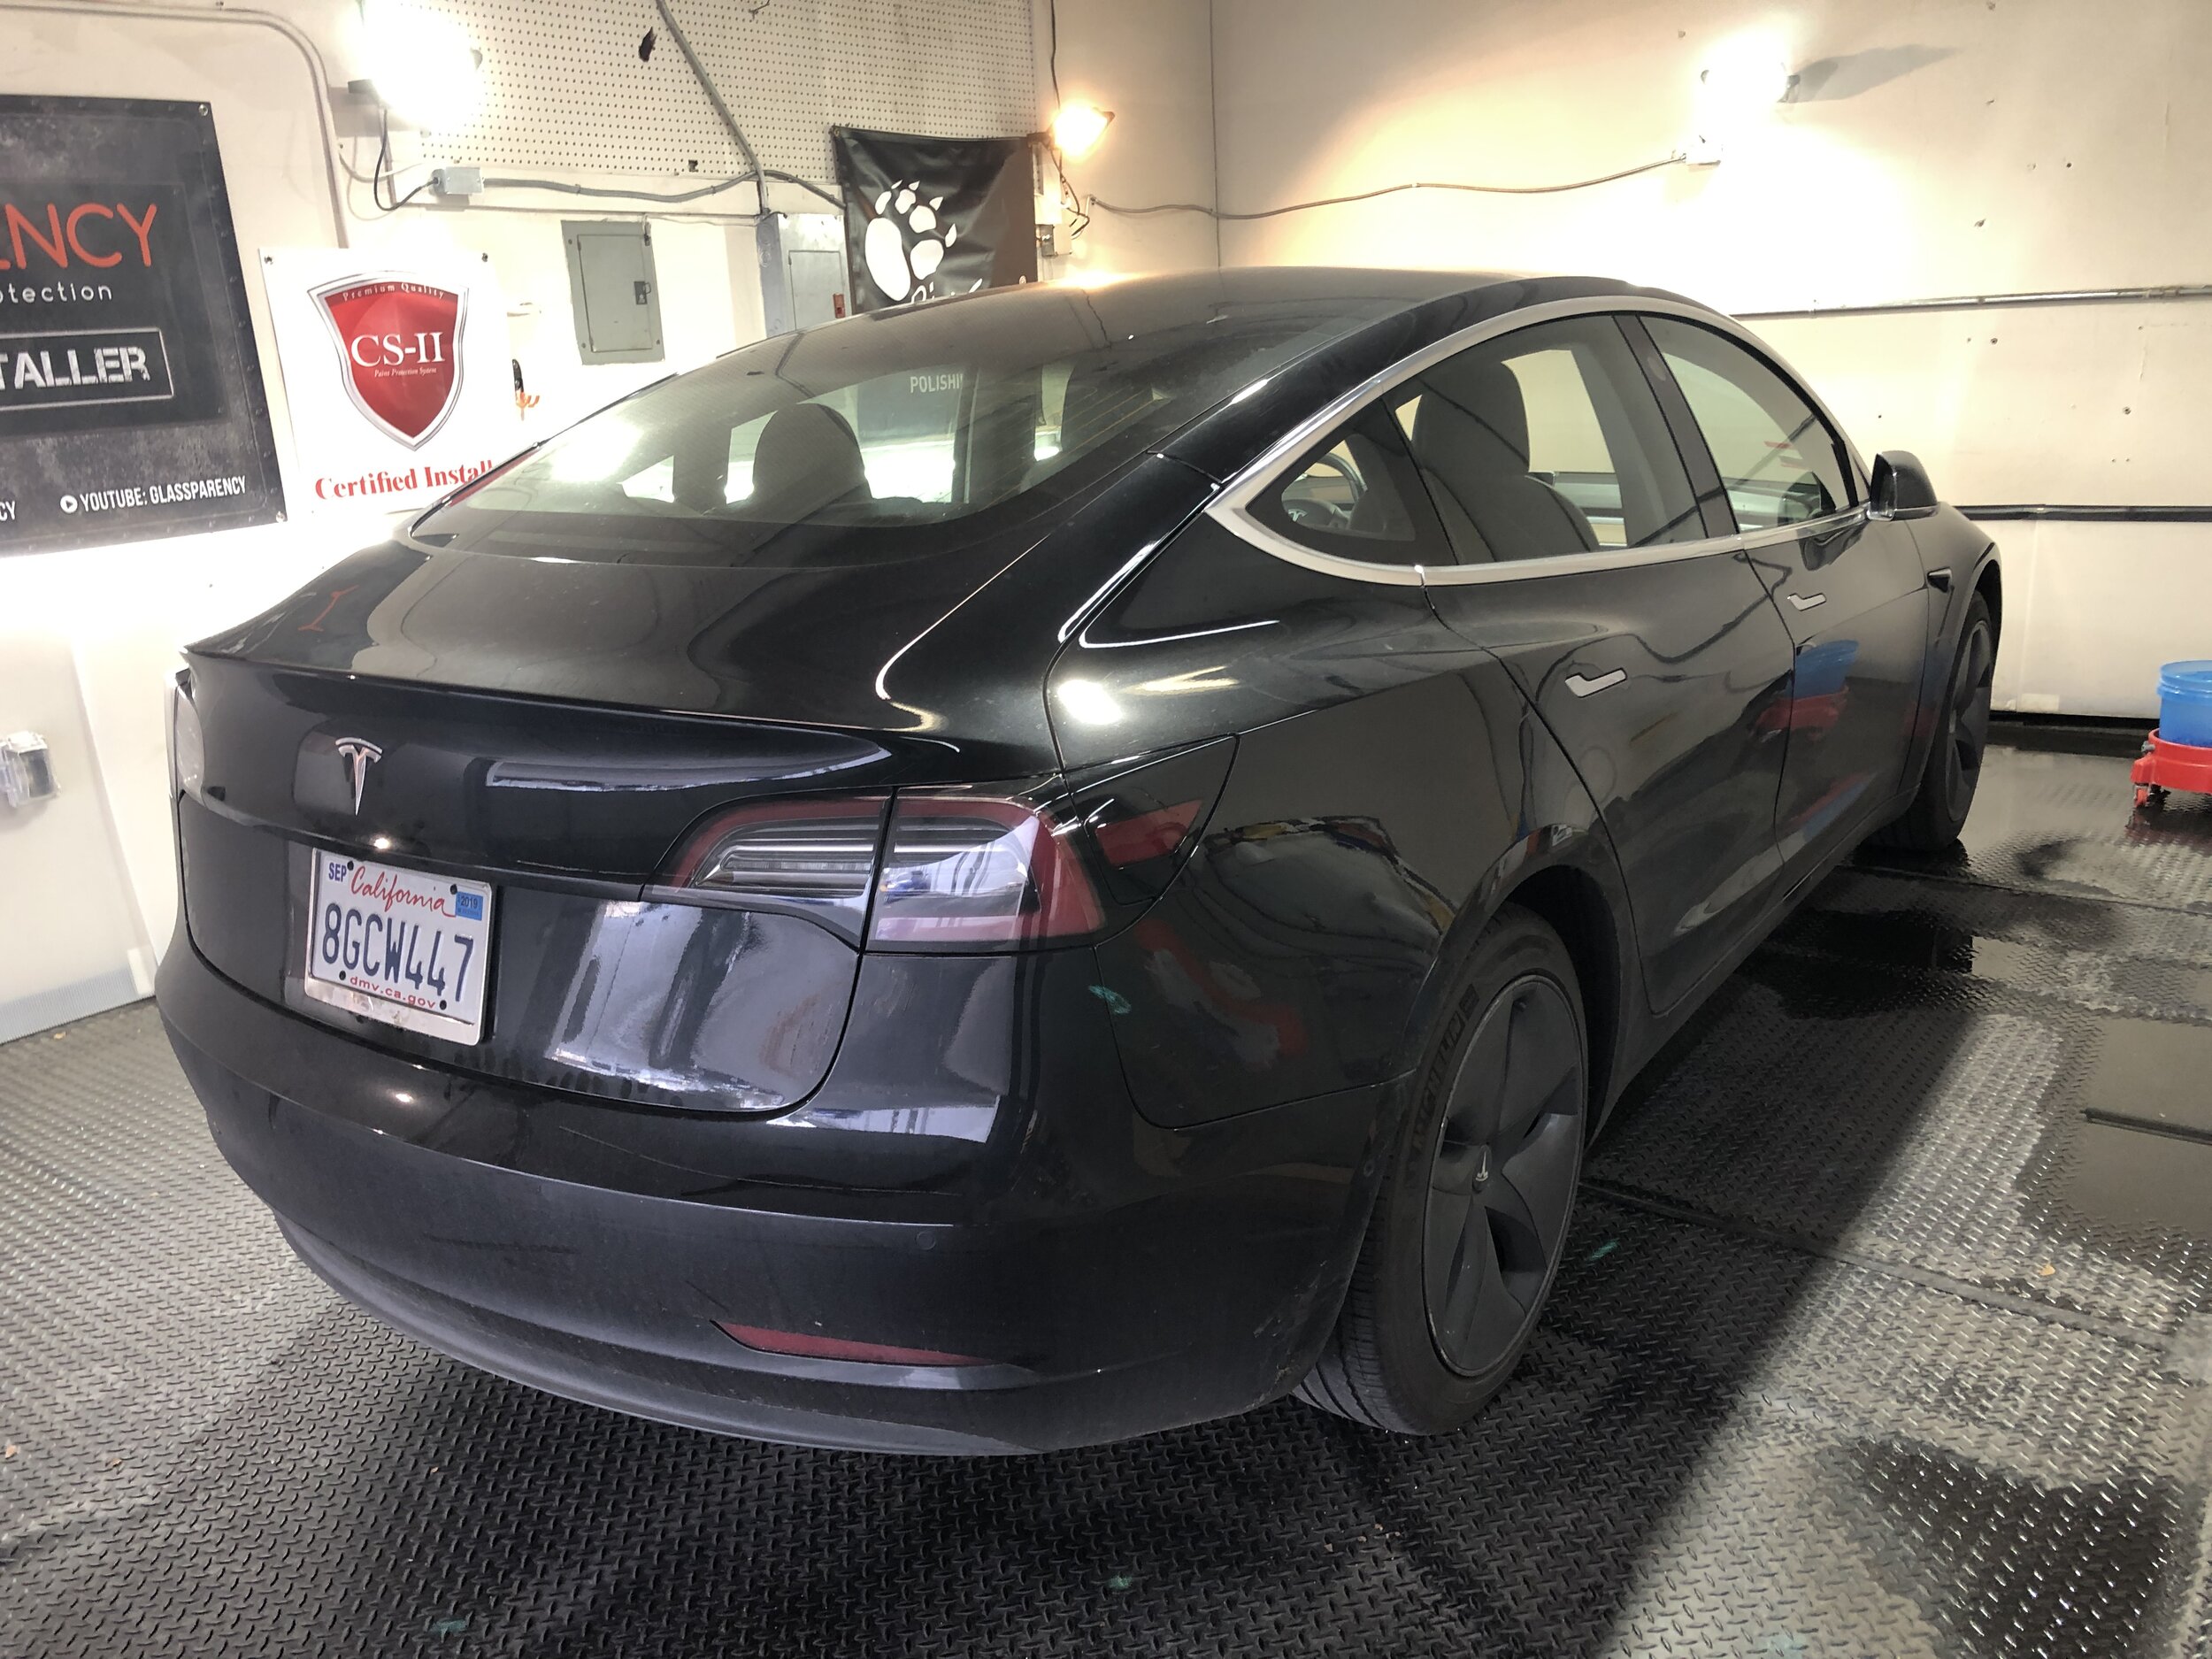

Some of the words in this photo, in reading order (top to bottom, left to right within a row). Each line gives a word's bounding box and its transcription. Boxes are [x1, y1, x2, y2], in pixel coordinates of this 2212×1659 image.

[0, 203, 157, 268] NCY
[343, 285, 396, 302] Premium
[401, 282, 444, 299] Quality
[350, 332, 445, 367] CS-II
[391, 367, 419, 377] Protection
[419, 367, 437, 377] System
[80, 488, 148, 511] YOUTUBE:
[150, 475, 246, 505] GLASSPARENCY
[315, 468, 418, 499] Certified
[328, 861, 347, 883] SEP
[350, 865, 457, 918] California
[460, 895, 479, 910] 2019
[322, 902, 474, 1002] 8GCW447
[349, 976, 436, 1010] dmv.ca.gov
